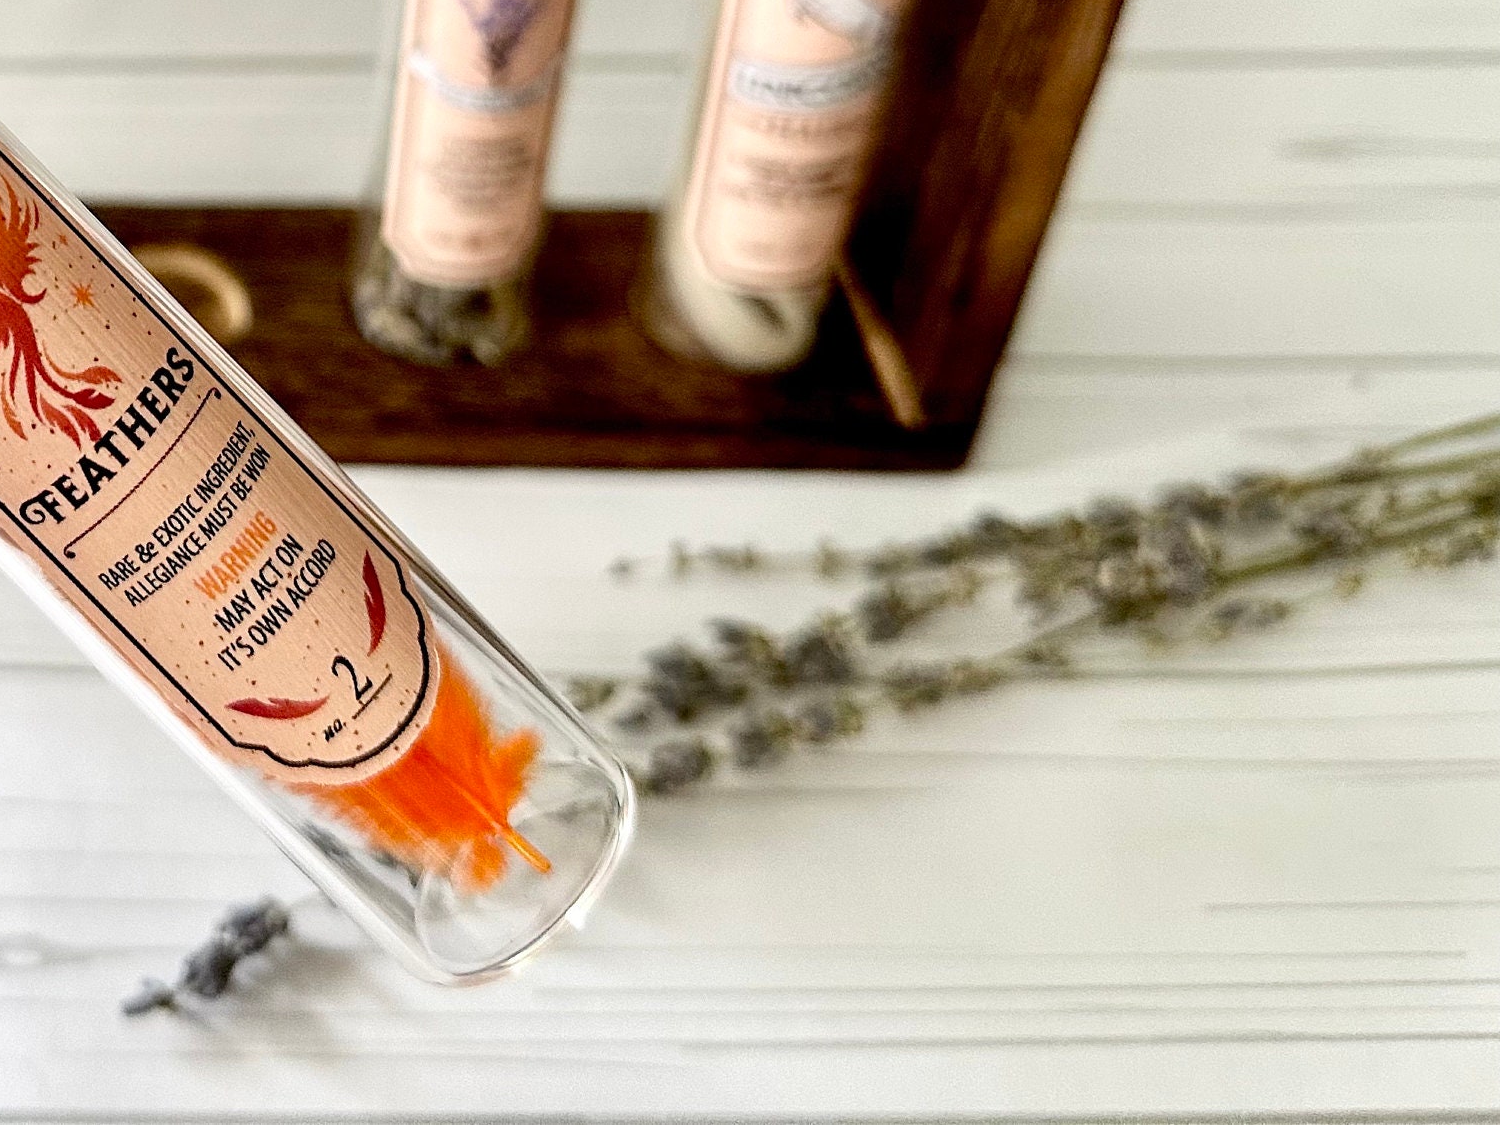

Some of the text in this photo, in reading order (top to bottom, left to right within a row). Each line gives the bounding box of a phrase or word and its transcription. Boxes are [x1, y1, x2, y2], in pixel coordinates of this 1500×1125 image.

[19, 346, 195, 525] FEATHERS
[98, 420, 256, 591] RARE & EXOTIC INGREDIENT,
[124, 442, 271, 607] ALLEGIANCE MUST BE WON
[193, 509, 278, 600] WARNING
[214, 533, 304, 633] MAY ACT ON
[217, 539, 336, 671] IT'S OWN ACCORD
[331, 655, 373, 700] 2
